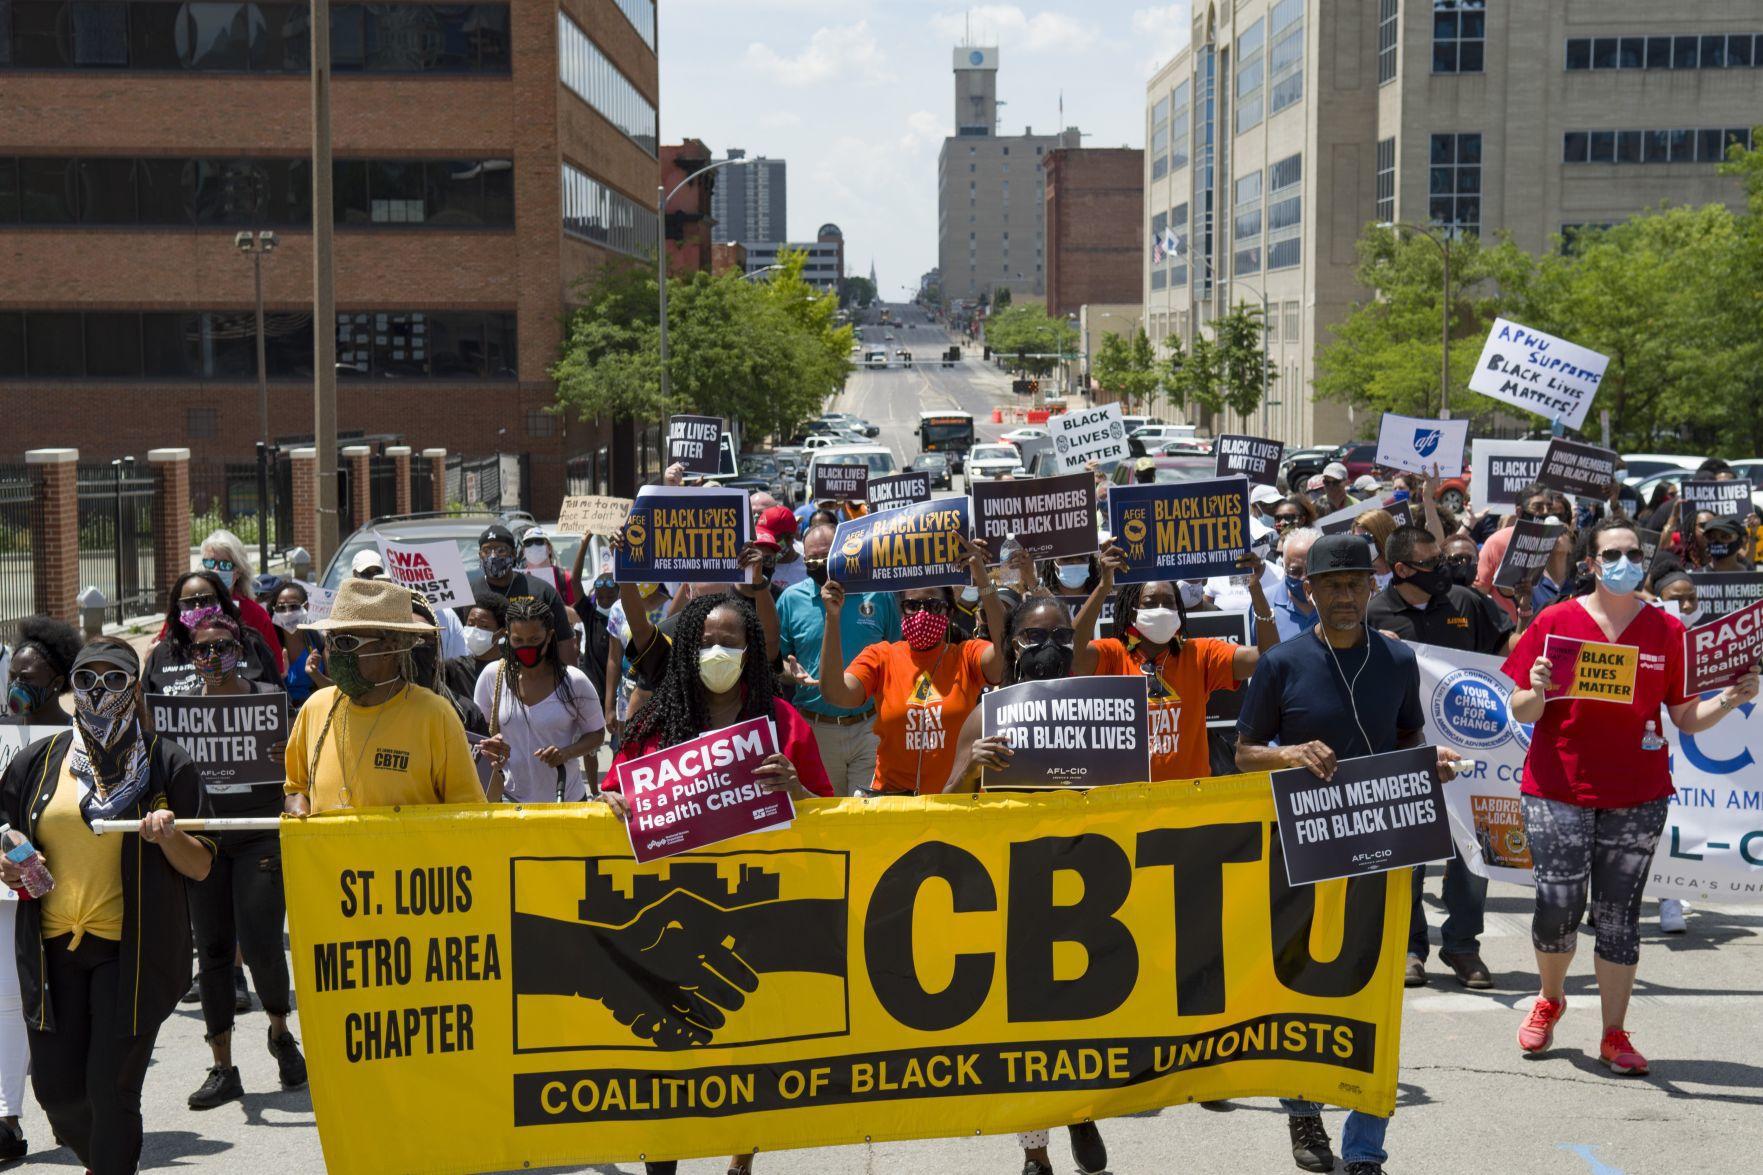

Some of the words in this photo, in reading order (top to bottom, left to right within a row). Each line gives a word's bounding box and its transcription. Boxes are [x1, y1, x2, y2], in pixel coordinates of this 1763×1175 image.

[1498, 326, 1550, 351] APWU
[1487, 354, 1541, 383] BLACK
[1528, 351, 1601, 383] SUPPORTS
[1499, 380, 1579, 416] MATTERS!
[1063, 410, 1109, 430] BLACK
[687, 423, 718, 441] LIVES
[1070, 429, 1109, 447] LIVES
[1065, 445, 1122, 467] MATTER
[1221, 439, 1250, 455] BLACK
[1252, 442, 1279, 460] LIVES
[1552, 450, 1578, 465] UNION
[1228, 455, 1266, 472] MATTER
[1492, 461, 1527, 476] BLACK
[1547, 462, 1564, 475] FOR
[1563, 466, 1590, 481] BLACK
[818, 468, 842, 479] BLACK
[845, 468, 866, 480] LIVES
[826, 480, 857, 491] MATTER
[869, 482, 893, 503] BLACK
[894, 479, 925, 498] LIVES
[1504, 477, 1533, 492] MATT
[1684, 486, 1716, 500] BLACK
[1717, 484, 1748, 499] LIVES
[983, 496, 1022, 516] UNION
[1025, 489, 1087, 513] MEMBERS
[1154, 496, 1199, 520] BLACK
[627, 515, 646, 525] AFGE
[654, 509, 695, 527] BLACK
[984, 520, 1009, 537] FOR
[1012, 515, 1051, 535] BLACK
[1055, 509, 1088, 530] LIVES
[1124, 508, 1146, 520] AFGE
[872, 513, 919, 536] BLACK
[654, 529, 737, 558] MATTER
[846, 530, 864, 541] AFGE
[1156, 516, 1243, 554] MATTER
[1516, 534, 1540, 551] UNION
[386, 548, 430, 567] CWA
[872, 531, 961, 568] MATTER
[1156, 554, 1176, 567] AFGE
[1177, 552, 1207, 565] STANDS
[1208, 550, 1228, 562] WITH
[1510, 551, 1528, 567] FOR
[654, 558, 671, 569] AFGE
[673, 558, 700, 569] STANDS
[702, 558, 720, 569] WITH
[872, 567, 891, 579] AFGE
[893, 564, 923, 578] STANDS
[924, 563, 944, 575] WITH
[1697, 600, 1712, 614] OR
[1714, 600, 1745, 614] BLACK
[1696, 606, 1763, 652] RACI
[1582, 651, 1624, 665] BLACK
[1696, 654, 1709, 665] is
[1714, 650, 1723, 659] a
[1697, 653, 1748, 677] Health
[1580, 667, 1616, 680] LIVES
[1462, 685, 1489, 699] YOUR
[1578, 682, 1631, 696] MATTER
[996, 700, 1047, 725] UNION
[1052, 698, 1135, 722] MEMBERS
[1455, 695, 1497, 710] CHANCE
[154, 706, 217, 733] BLACK
[222, 705, 279, 732] LIVES
[906, 705, 943, 731] STAY
[1148, 707, 1181, 733] TAY
[1463, 707, 1486, 719] FOR
[1452, 715, 1498, 732] CHANGE
[905, 730, 946, 750] READY
[1033, 726, 1087, 749] BLACK
[1092, 726, 1136, 750] LIVES
[1149, 733, 1179, 754] EADY
[177, 736, 257, 762] MATTER
[375, 752, 409, 769] CBTU
[631, 729, 764, 794] RACISM
[635, 797, 652, 812] is
[657, 793, 668, 806] a
[672, 772, 732, 801] Public
[1289, 785, 1343, 816] UNION
[1345, 770, 1432, 807] MEMBERS
[1667, 787, 1715, 808] ATIN
[639, 800, 702, 831] Health
[1474, 798, 1522, 813] LABORE
[1295, 818, 1329, 845] FOR
[1332, 807, 1388, 839] BLACK
[1390, 799, 1437, 829] LIVES
[1488, 812, 1519, 825] LOCAL
[1352, 849, 1392, 862] AFL-CIO
[340, 869, 383, 918] ST.
[394, 865, 473, 914] LOUIS
[1653, 874, 1718, 890] RICA'S
[863, 821, 1389, 1032] CBTU
[314, 936, 412, 993] METRO
[425, 933, 501, 985] AREA
[345, 1003, 474, 1063] CHAPTER
[540, 1073, 755, 1115] COALITION
[778, 1067, 832, 1101] OF
[851, 1053, 983, 1094] BLACK
[1000, 1047, 1129, 1084] TRADE
[1153, 1022, 1354, 1073] UNIONISTS
